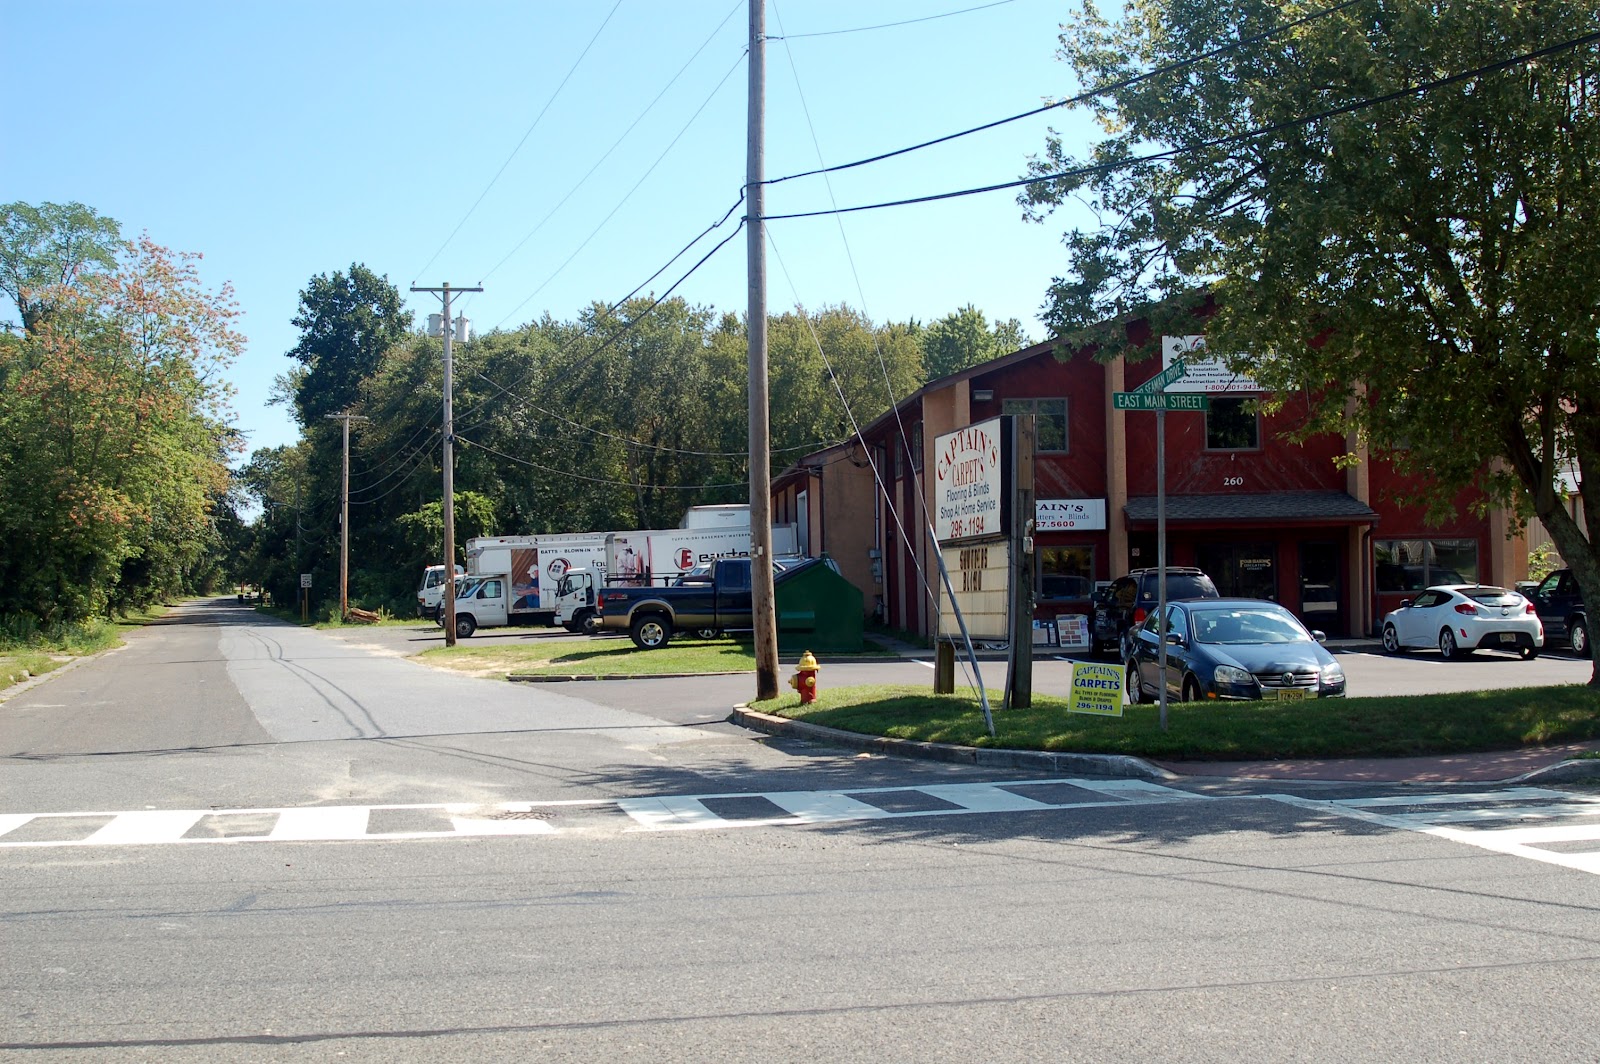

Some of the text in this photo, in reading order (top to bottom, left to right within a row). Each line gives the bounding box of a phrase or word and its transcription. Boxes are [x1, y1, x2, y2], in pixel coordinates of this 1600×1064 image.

[1145, 363, 1182, 393] SEAMAN DRIVE
[1118, 395, 1202, 408] EAST MAIN STREET
[937, 428, 998, 481] CAPTAIN'S
[952, 457, 985, 487] CARPET'S
[1223, 477, 1244, 486] 260
[946, 481, 990, 502] Flooring & Blinds
[940, 499, 996, 520] Shop At Home Service
[1036, 503, 1084, 513] AIN'S
[950, 520, 963, 538] 296
[968, 515, 984, 535] 1194
[681, 549, 693, 568] E
[1076, 665, 1120, 680] CAPTAIN'S
[1074, 678, 1120, 690] CARPETS
[1076, 702, 1113, 711] 296-1194
